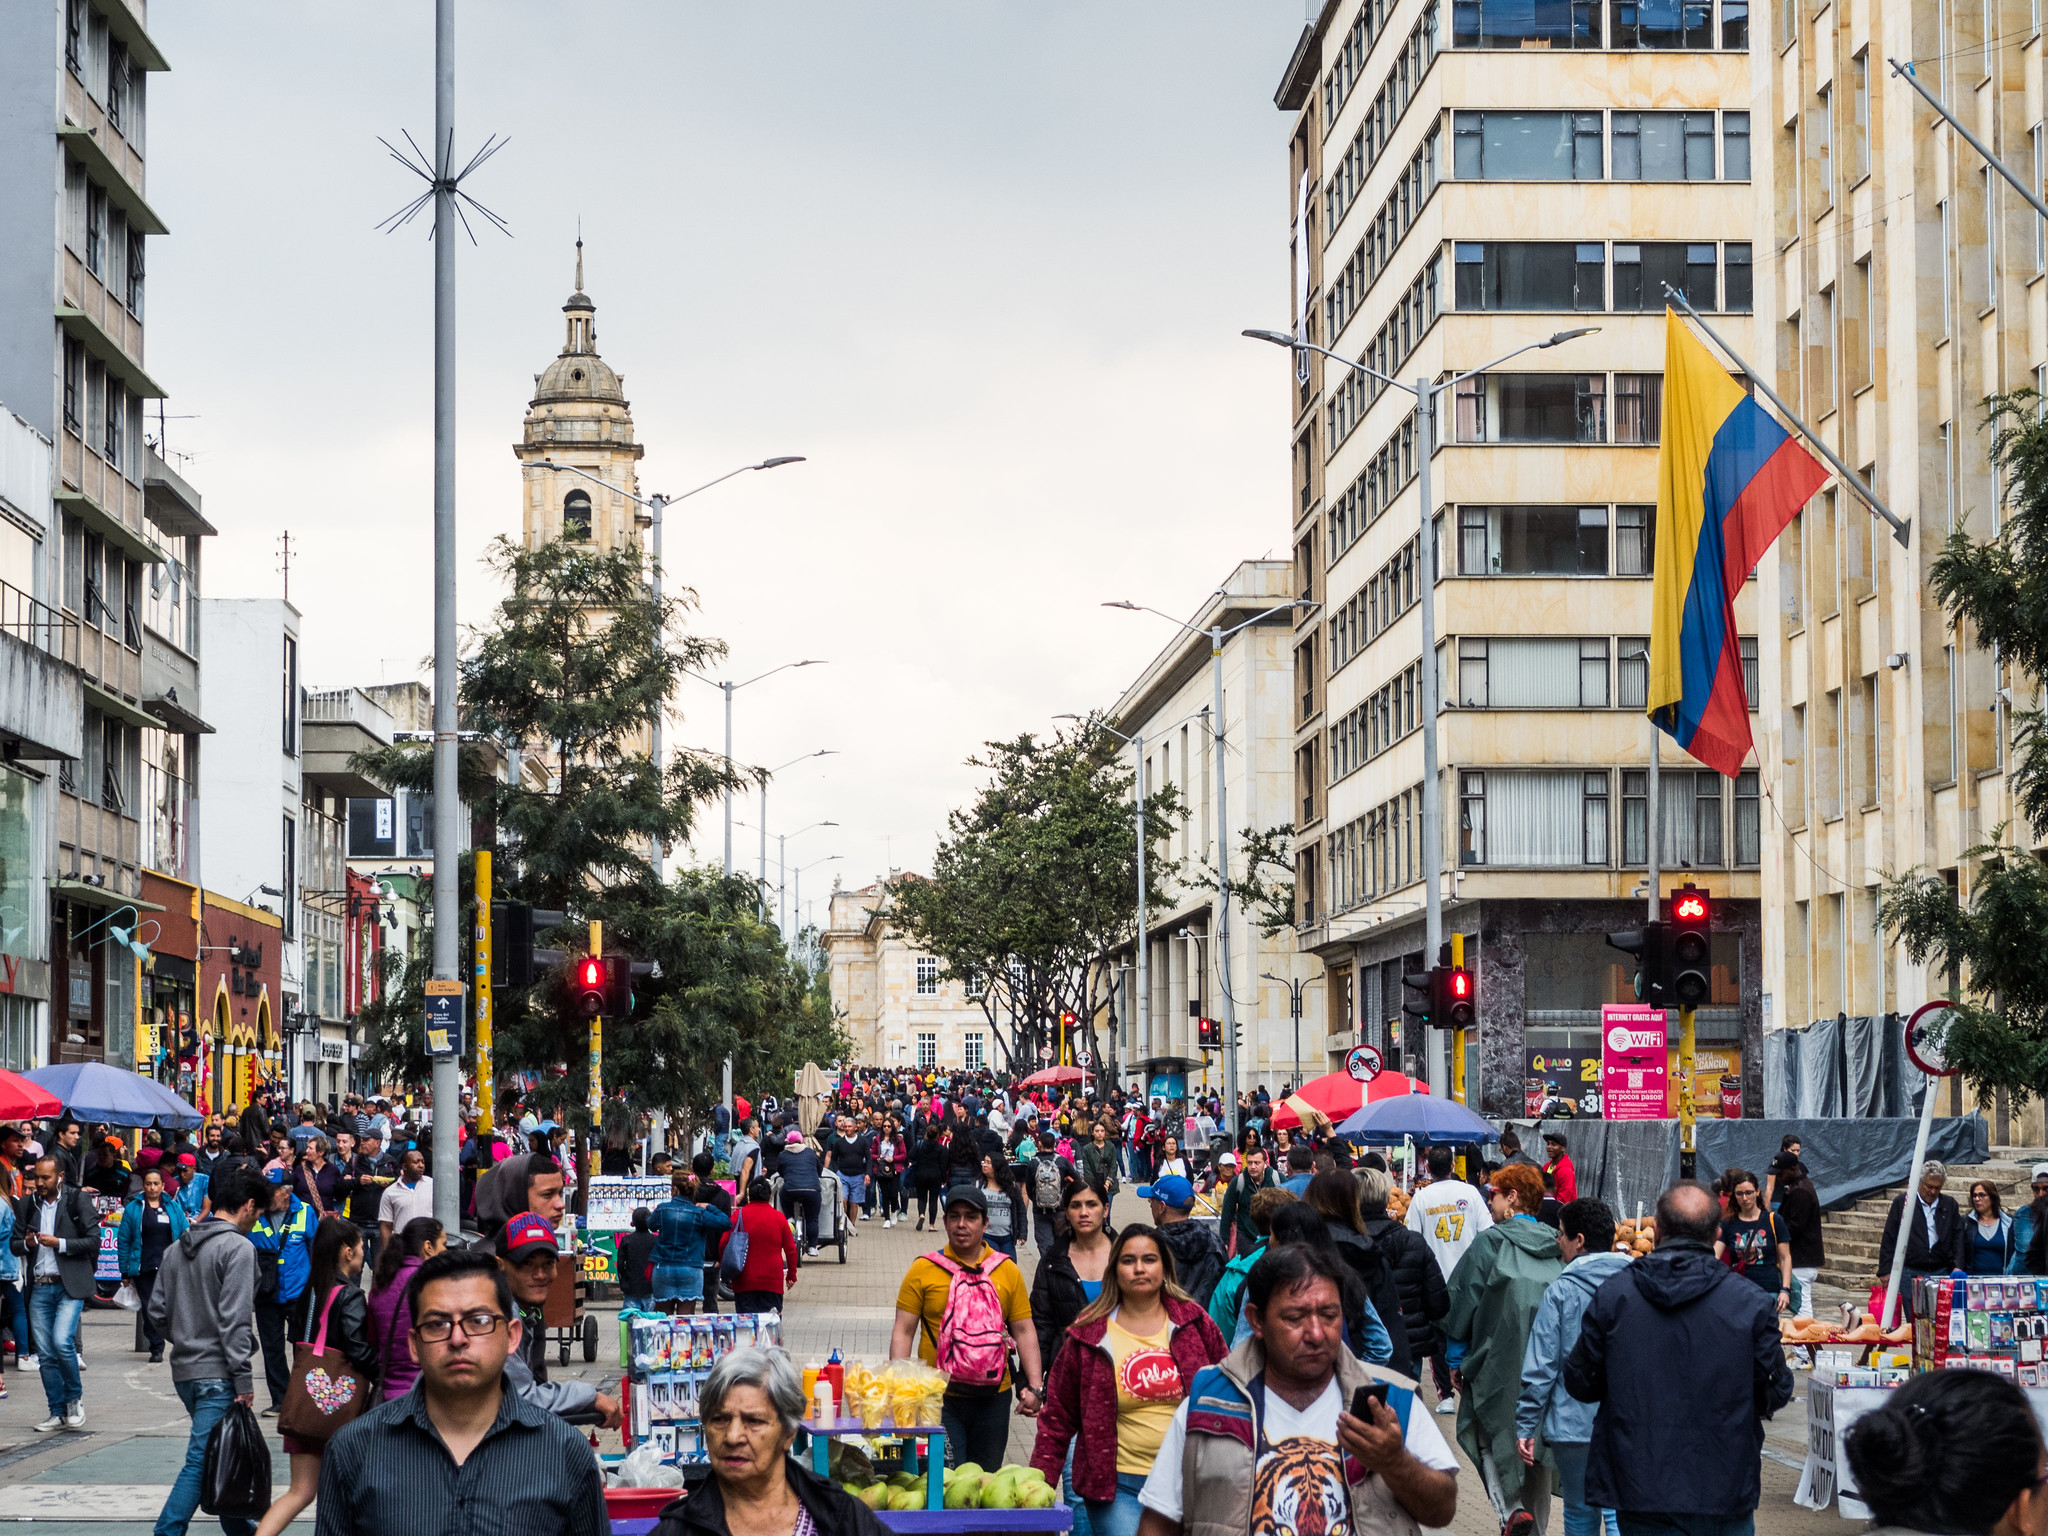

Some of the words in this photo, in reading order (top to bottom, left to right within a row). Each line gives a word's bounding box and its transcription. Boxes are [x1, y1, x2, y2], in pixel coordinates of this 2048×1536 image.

[1607, 1013, 1632, 1021] INTERNET
[1632, 1013, 1650, 1021] GRATIS
[150, 1025, 158, 1053] FOTOS
[1630, 1032, 1661, 1046] WiFi
[1435, 1214, 1465, 1242] 47
[583, 1256, 609, 1271] 5D
[588, 1271, 610, 1280] 3.000
[1138, 1362, 1180, 1389] Relax
